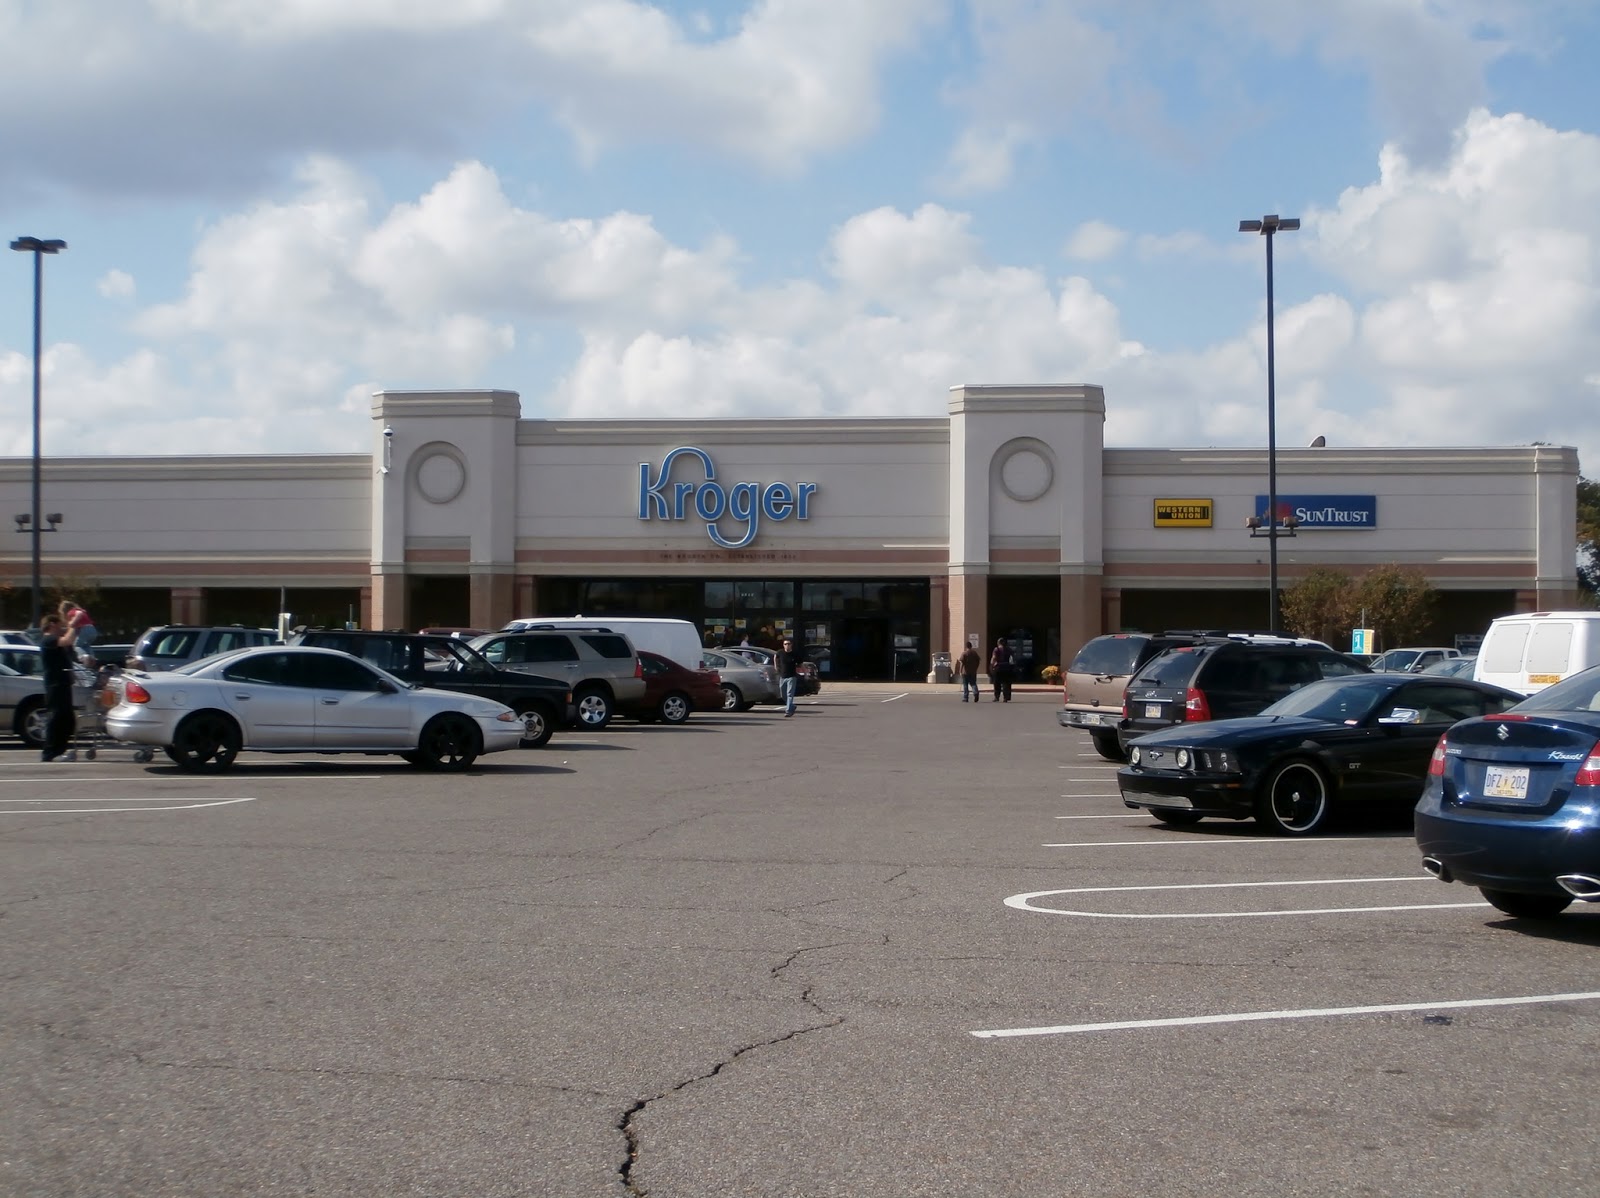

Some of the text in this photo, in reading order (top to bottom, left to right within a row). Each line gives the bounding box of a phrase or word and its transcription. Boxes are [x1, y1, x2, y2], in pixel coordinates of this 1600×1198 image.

[638, 446, 817, 549] Kroger
[1486, 773, 1527, 790] DFZ 202
